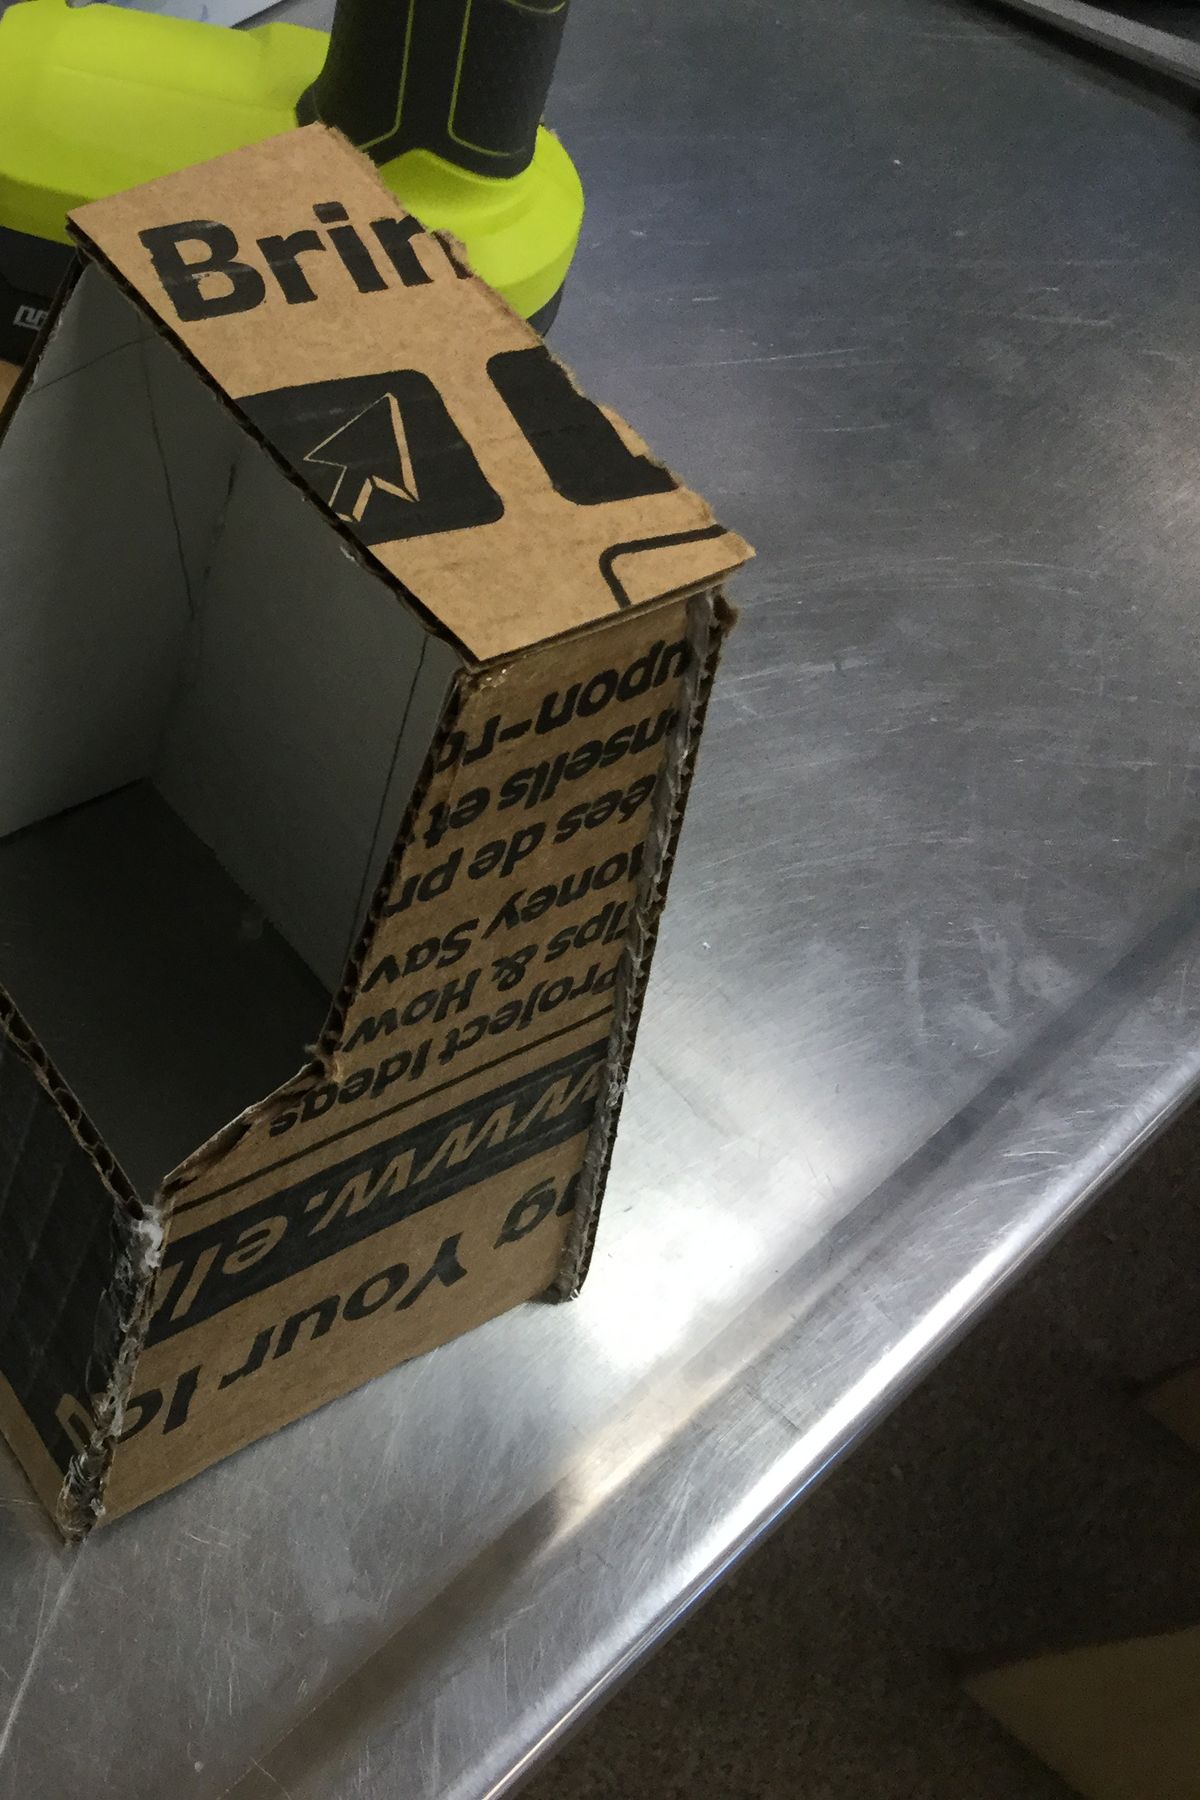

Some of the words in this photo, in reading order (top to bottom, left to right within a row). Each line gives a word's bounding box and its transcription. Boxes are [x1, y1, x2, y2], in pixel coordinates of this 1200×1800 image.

[423, 786, 491, 849] et
[467, 821, 547, 881] de
[360, 917, 480, 994] Sav
[490, 943, 540, 992] &
[342, 967, 483, 1052] How
[437, 962, 622, 1066] Project
[268, 1037, 434, 1138] Ideas
[150, 1061, 603, 1324] www.el
[216, 1231, 469, 1390] Your
